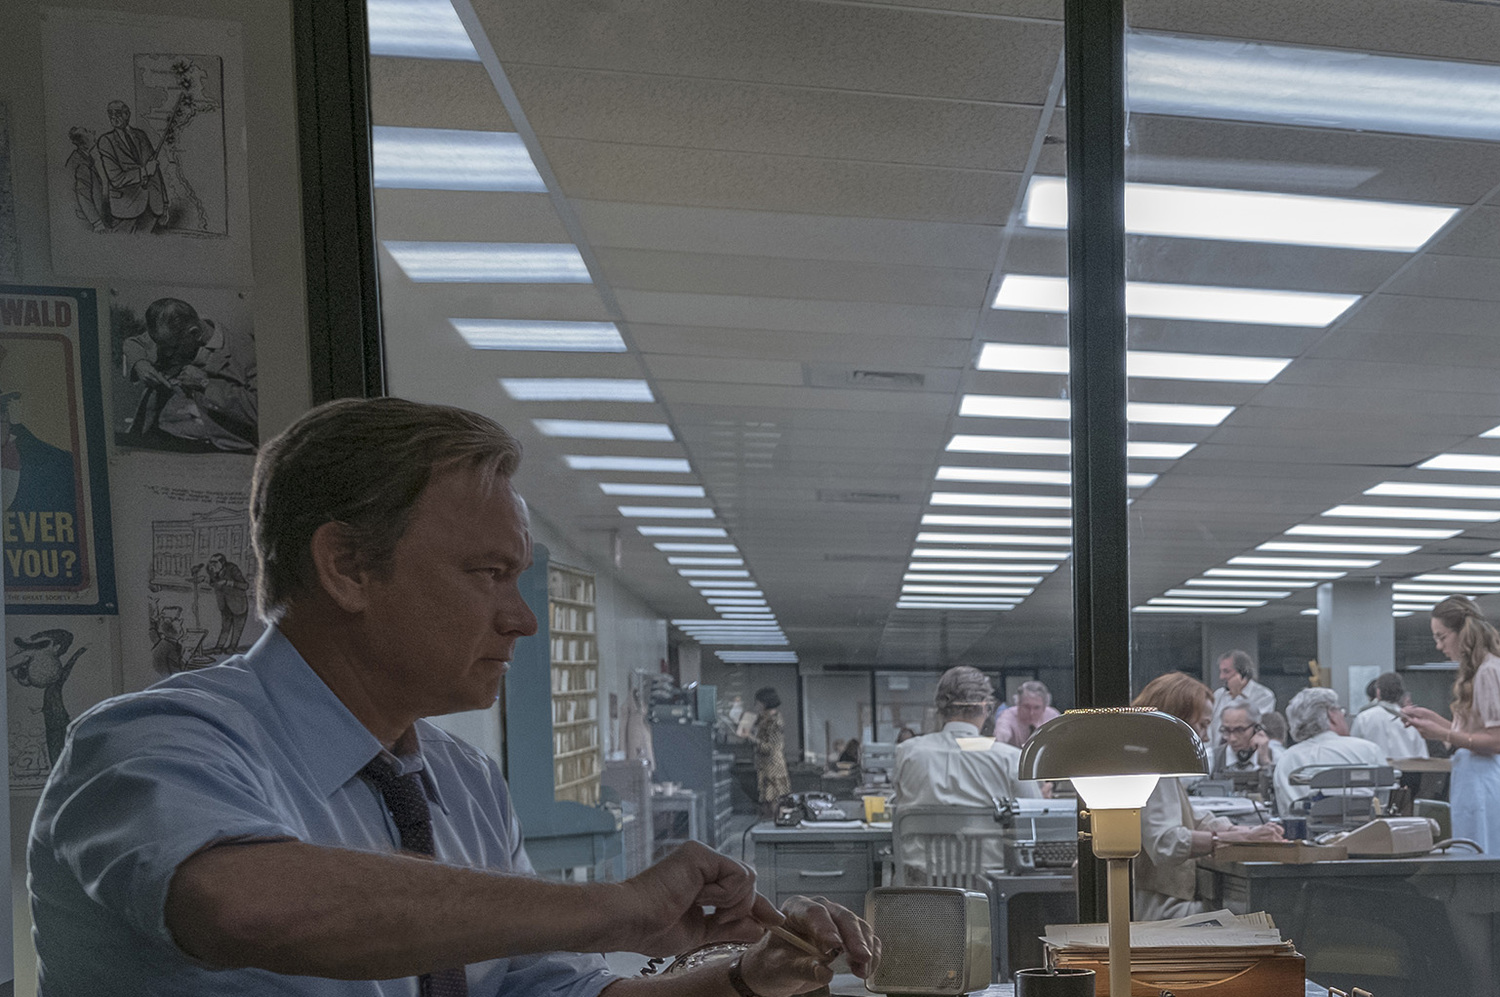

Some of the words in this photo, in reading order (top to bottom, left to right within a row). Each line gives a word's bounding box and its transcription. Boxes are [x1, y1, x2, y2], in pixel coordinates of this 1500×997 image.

[0, 298, 72, 328] WALD
[3, 511, 75, 542] EVER
[6, 549, 77, 578] YOU?
